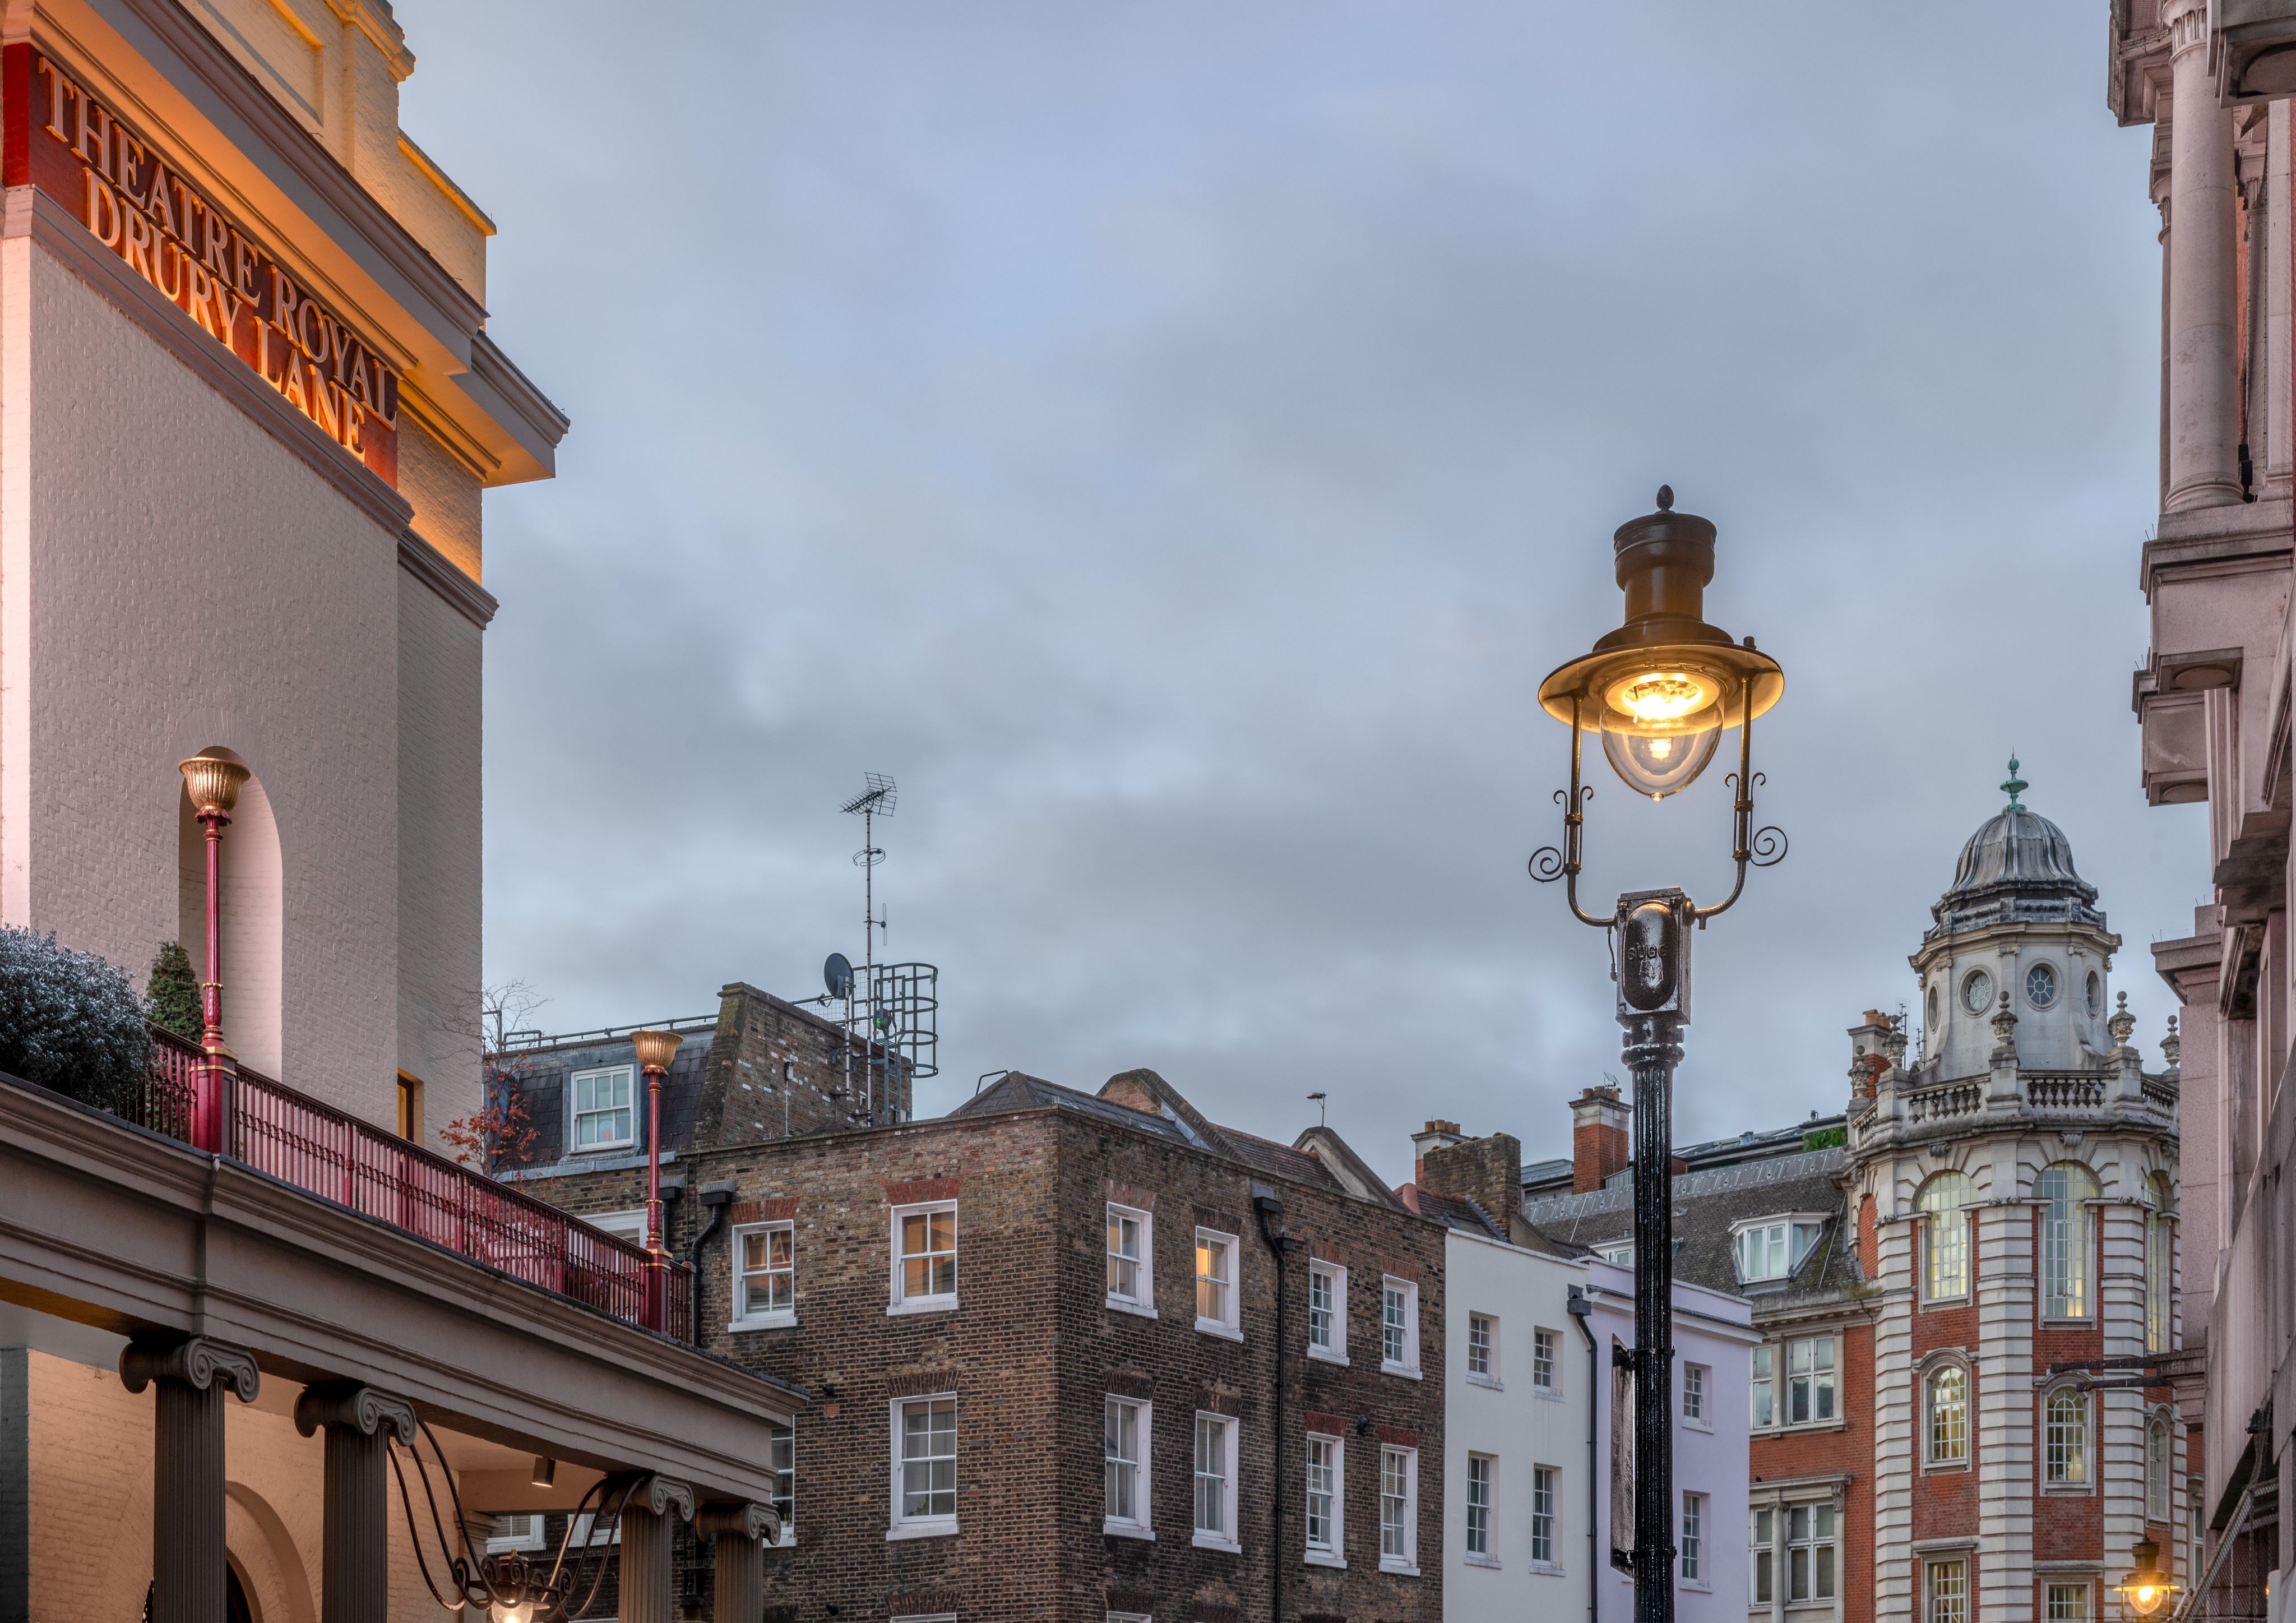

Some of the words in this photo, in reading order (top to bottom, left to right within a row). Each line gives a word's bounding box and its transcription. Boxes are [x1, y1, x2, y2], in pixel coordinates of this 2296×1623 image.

[39, 57, 260, 308] THEATRE
[269, 264, 397, 431] ROYAL
[82, 167, 243, 356] DRURY
[253, 316, 365, 463] LANE
[1627, 945, 1668, 960] SUGG
